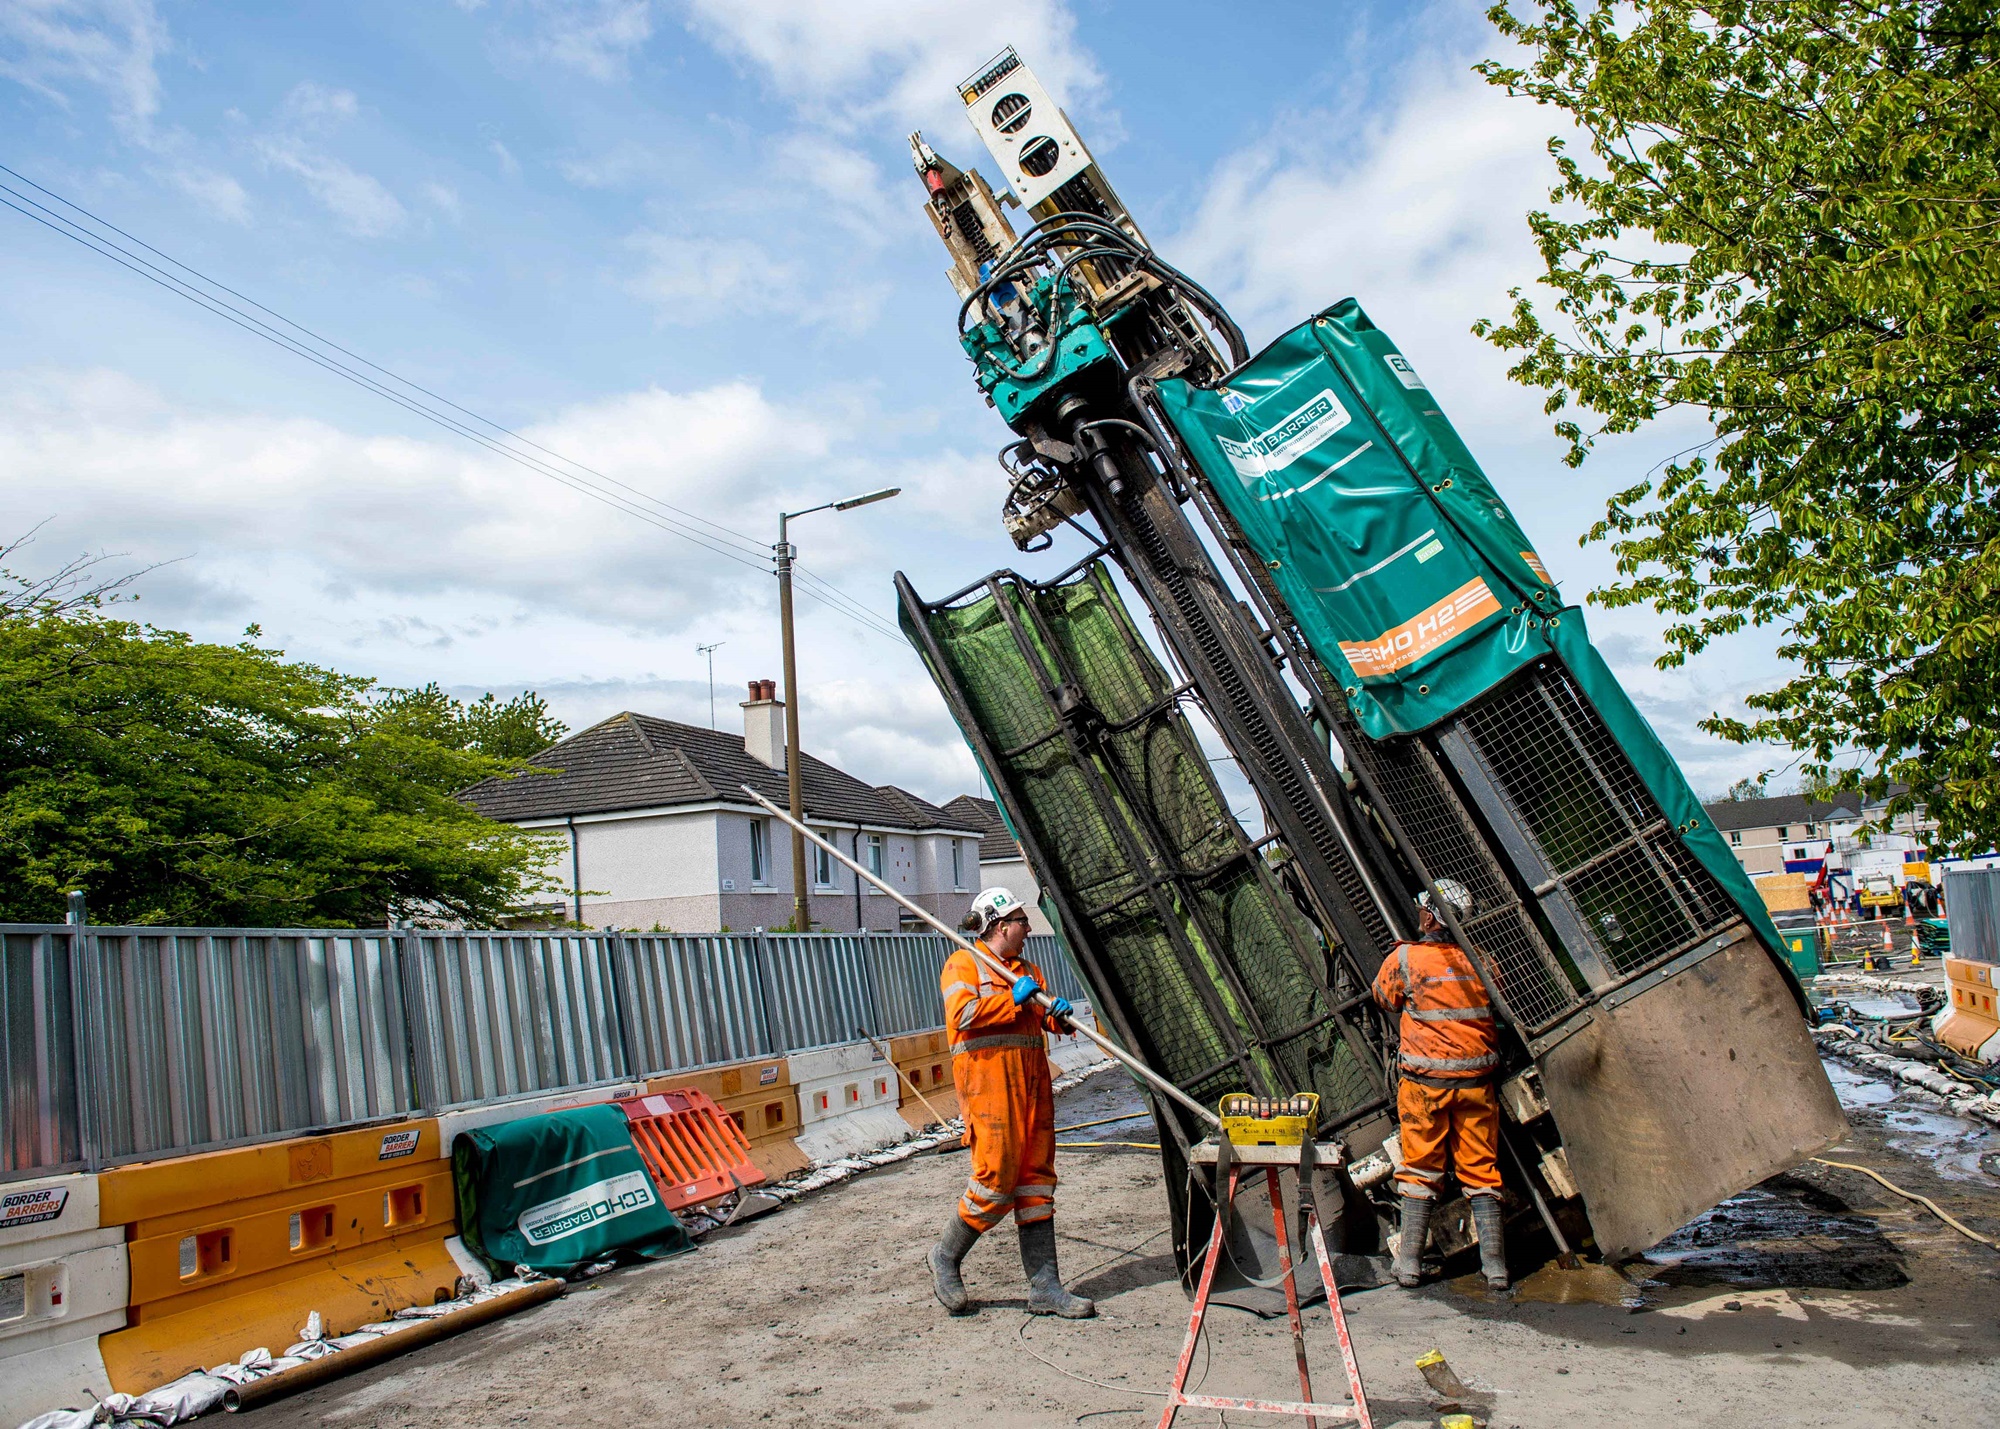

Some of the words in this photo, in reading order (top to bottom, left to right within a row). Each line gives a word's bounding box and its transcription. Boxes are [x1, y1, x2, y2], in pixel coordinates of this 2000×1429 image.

[1267, 400, 1329, 447] BARRIER
[1273, 423, 1319, 457] Environmentally
[1317, 410, 1338, 426] Sound
[1362, 630, 1413, 663] ECHO
[1417, 604, 1456, 640] H2
[1420, 625, 1456, 650] SYSTEM
[383, 1133, 410, 1144] BORDER
[385, 1140, 415, 1152] BARRIERS
[3, 1191, 51, 1208] BORDER
[6, 1200, 61, 1218] BARRIERS
[591, 1187, 650, 1219] ECHO
[543, 1201, 589, 1221] Environmentally
[525, 1217, 544, 1228] Sound
[533, 1212, 590, 1239] BARRIER
